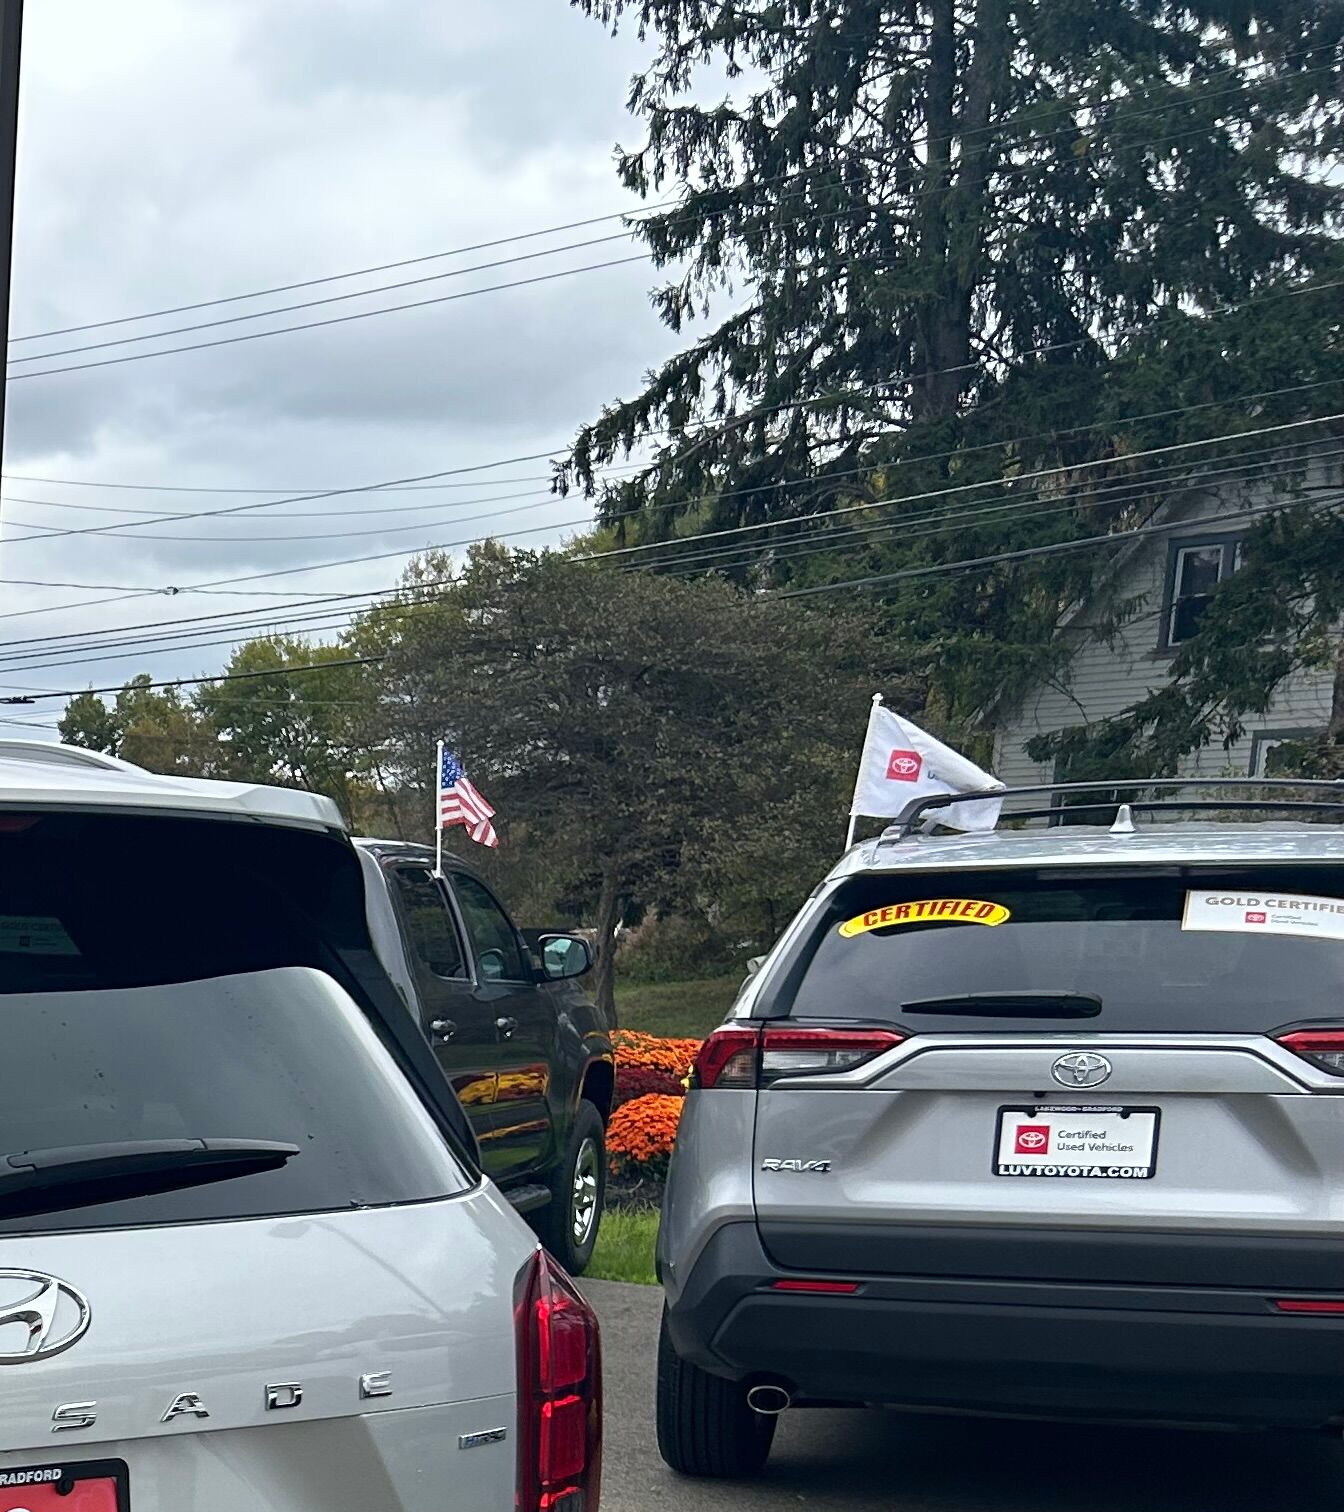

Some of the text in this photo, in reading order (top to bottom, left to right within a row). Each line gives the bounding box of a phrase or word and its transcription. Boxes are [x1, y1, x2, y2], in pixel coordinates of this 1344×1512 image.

[1205, 896, 1261, 907] GOLD
[863, 900, 996, 927] CERTIFIED
[1057, 1130, 1107, 1140] Certified
[1057, 1143, 1134, 1153] Used Vehicles
[761, 1158, 832, 1172] RAV4
[999, 1164, 1148, 1178] LUVTOYOTA.COM
